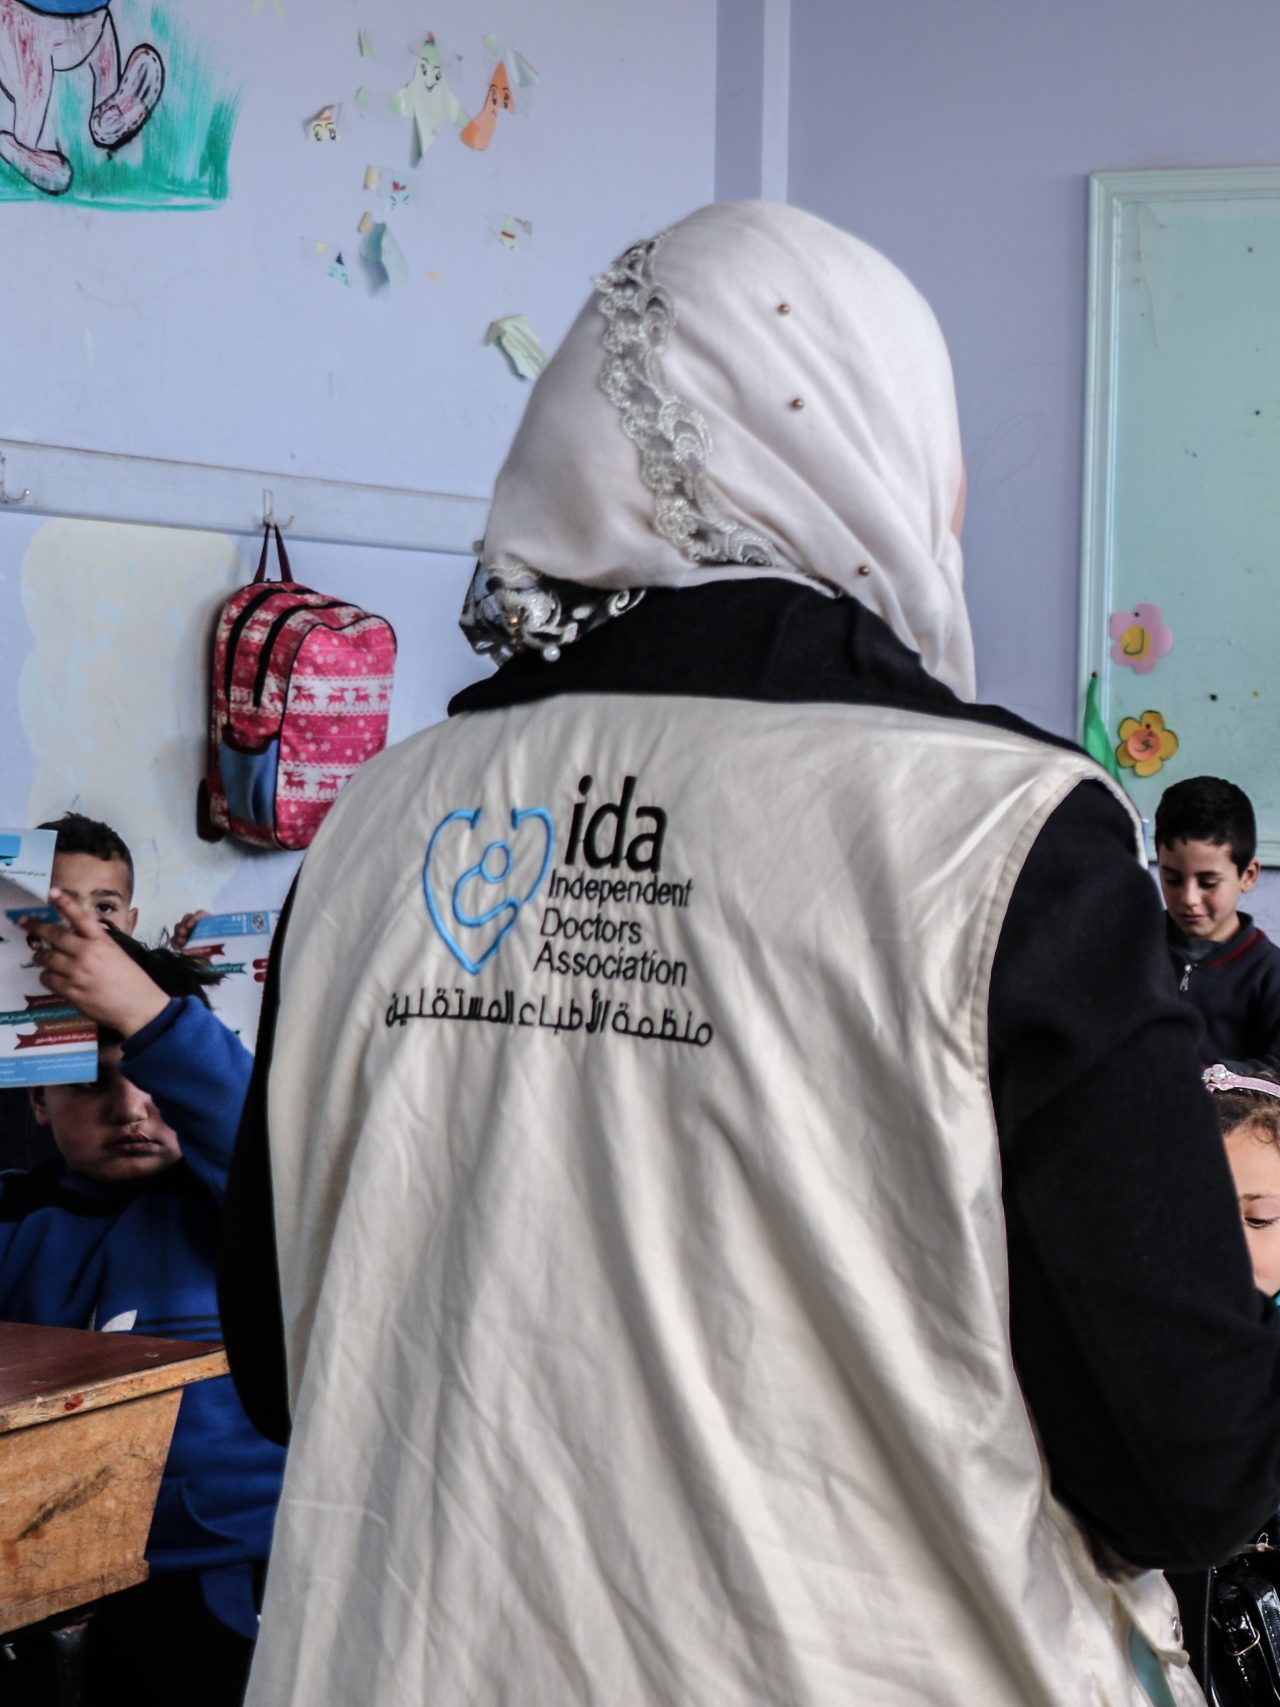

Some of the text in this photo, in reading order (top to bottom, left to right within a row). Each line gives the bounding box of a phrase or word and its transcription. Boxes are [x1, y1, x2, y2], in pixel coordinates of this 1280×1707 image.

[564, 775, 669, 873] ida
[548, 870, 695, 908] Independent
[540, 908, 643, 945] Doctors
[533, 941, 689, 987] Association
[519, 988, 611, 1036] الأطباء
[613, 1003, 714, 1047] منظمة
